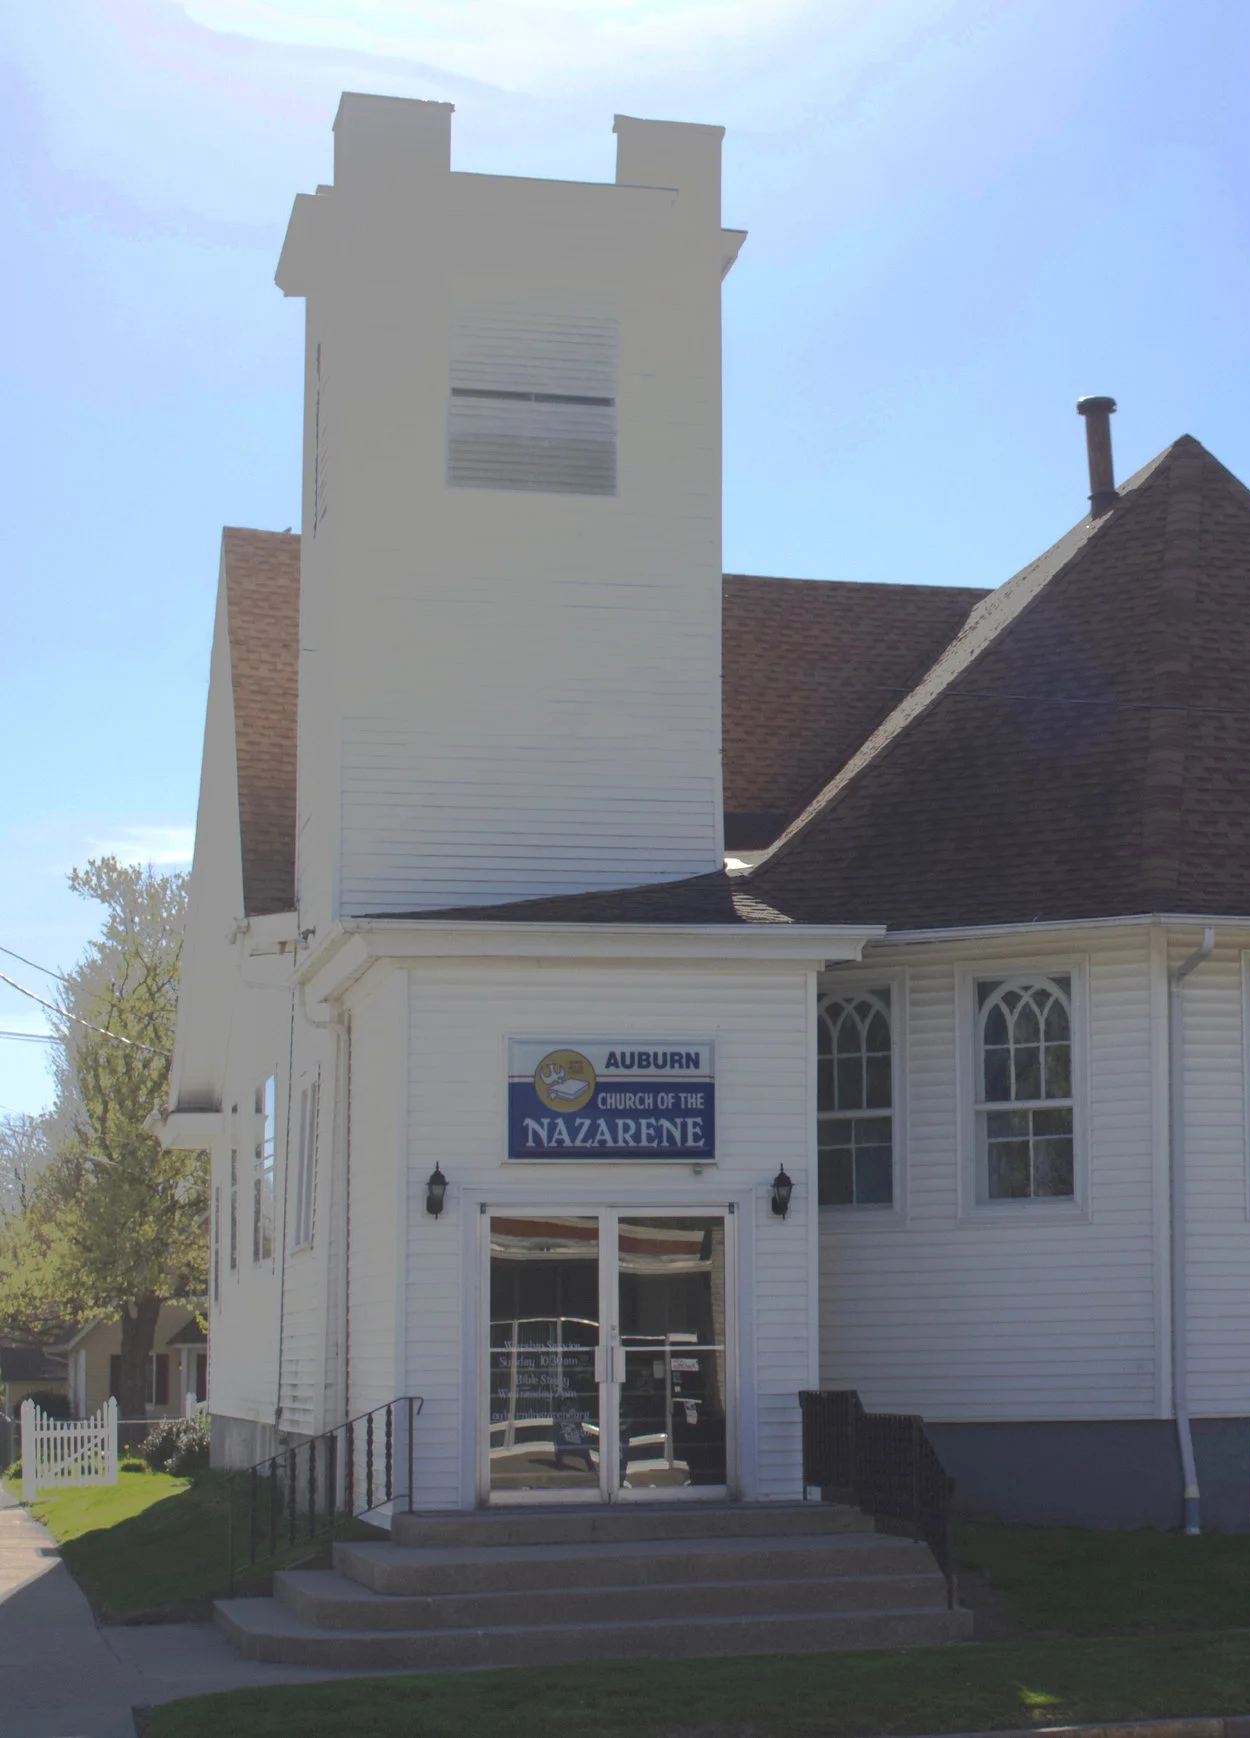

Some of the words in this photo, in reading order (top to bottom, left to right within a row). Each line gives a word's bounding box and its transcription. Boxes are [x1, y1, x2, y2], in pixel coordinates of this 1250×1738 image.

[605, 1051, 700, 1070] AUBURN
[597, 1092, 653, 1109] CHURCH
[658, 1092, 676, 1109] OF
[680, 1093, 705, 1109] THE
[523, 1117, 706, 1148] NAZARENE
[498, 1355, 535, 1369] Suday
